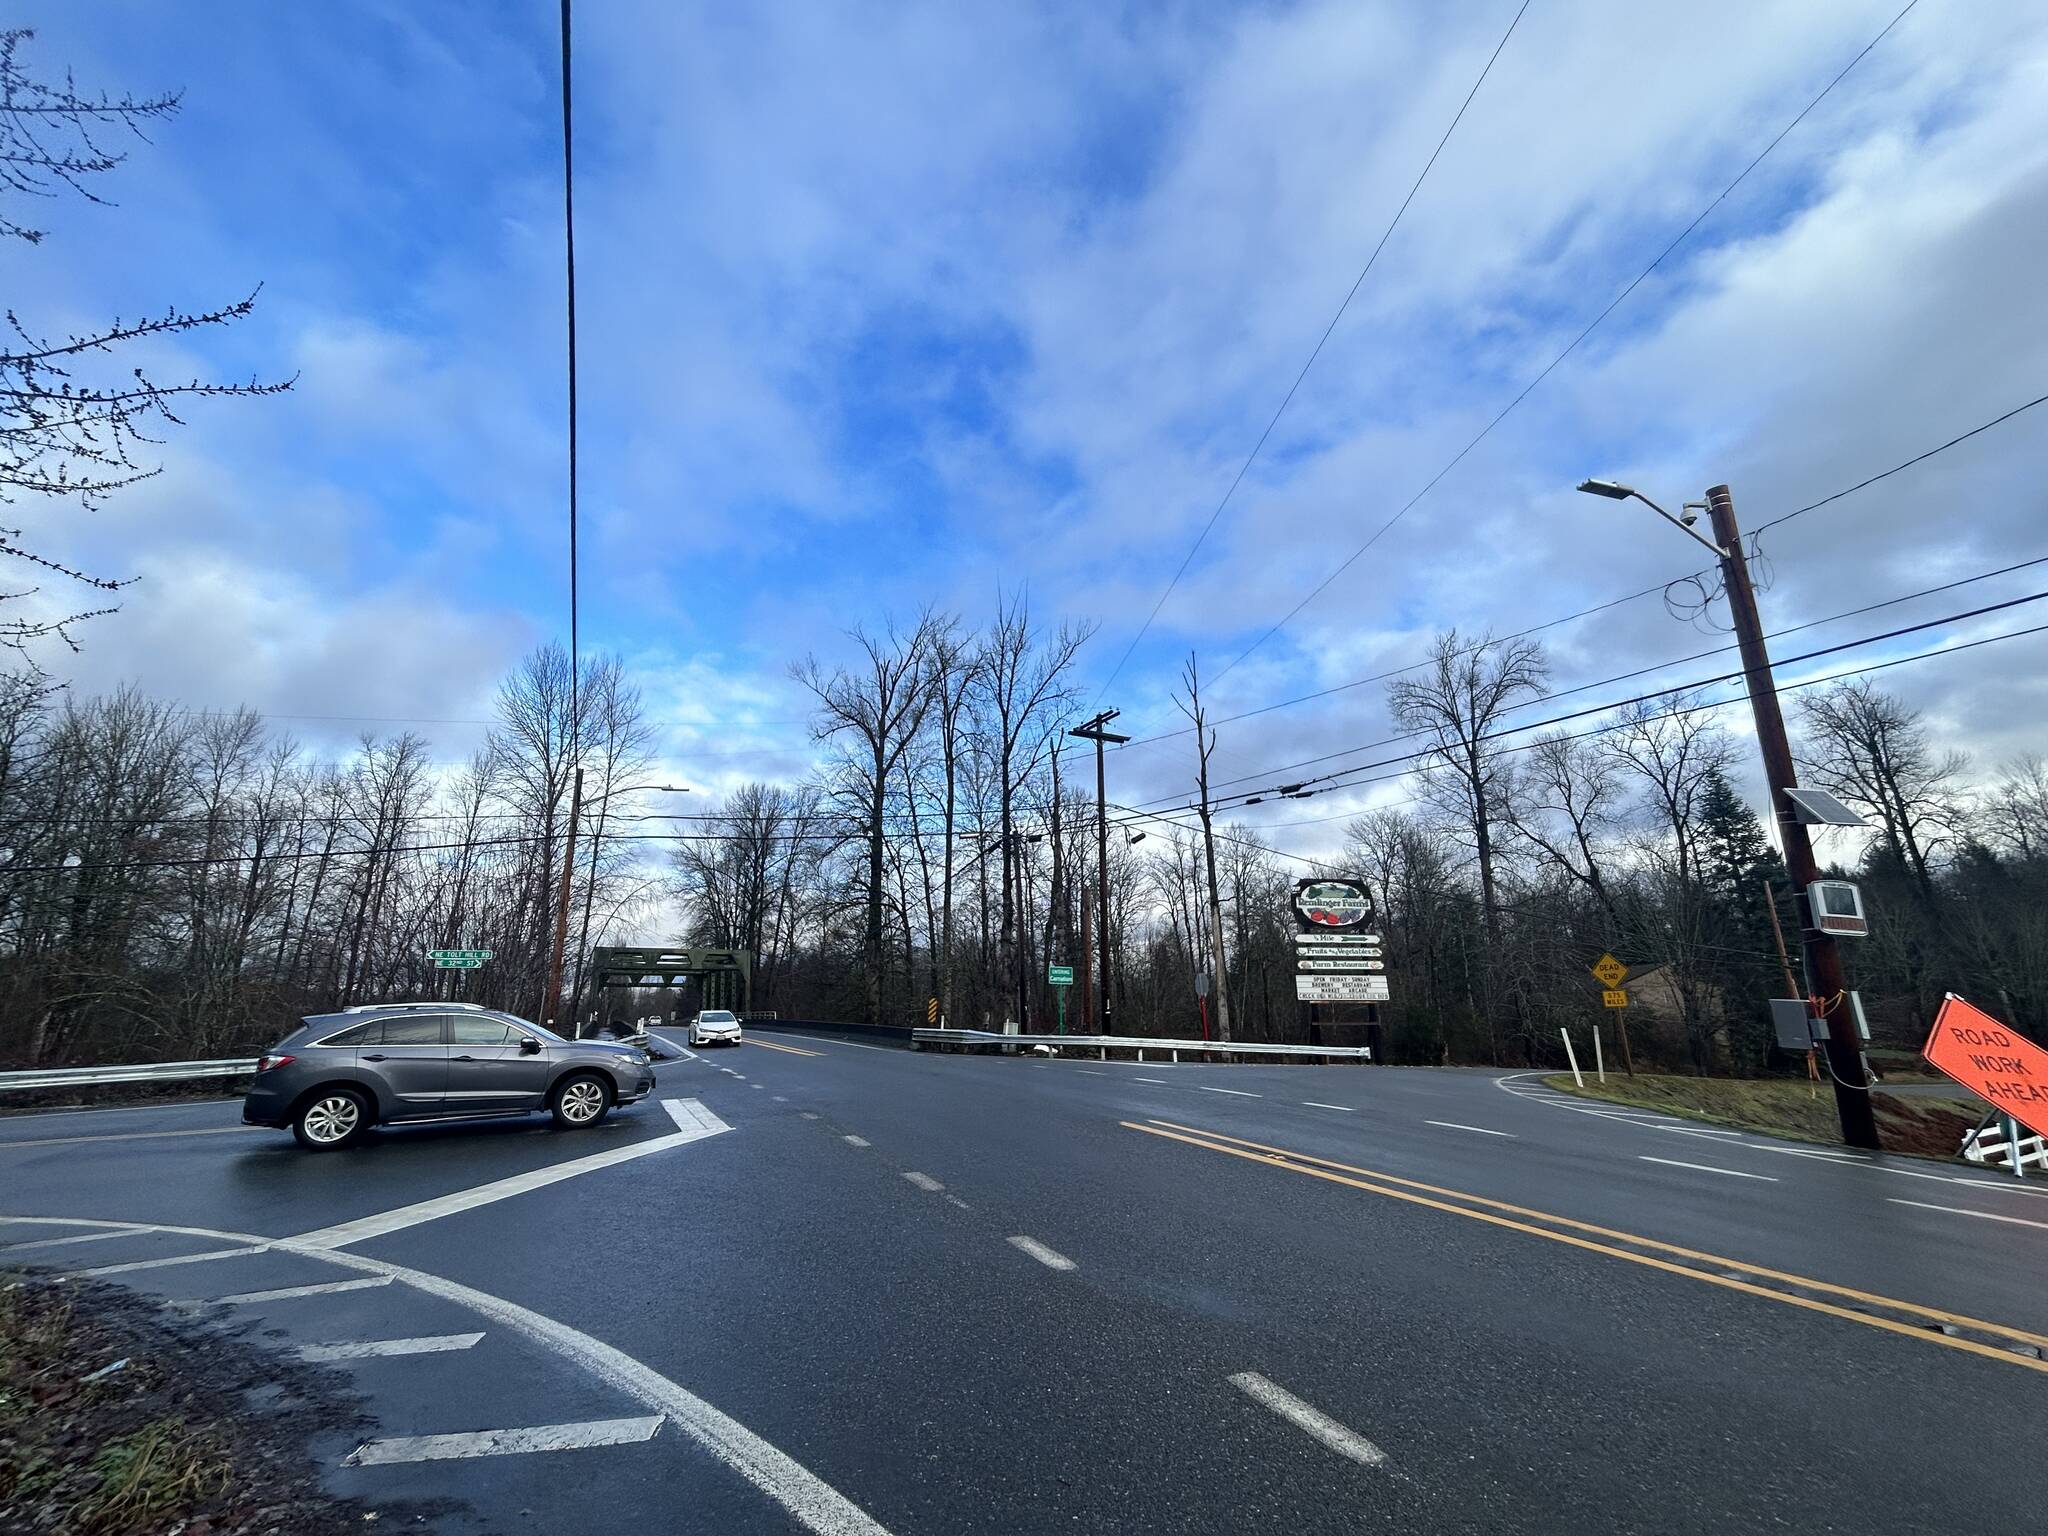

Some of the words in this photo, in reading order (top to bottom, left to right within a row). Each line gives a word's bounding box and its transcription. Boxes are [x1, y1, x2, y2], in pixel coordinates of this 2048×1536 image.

[1298, 897, 1341, 908] Remlinger
[1342, 898, 1369, 908] Farms
[1337, 948, 1371, 956] Vegetables
[1599, 963, 1620, 971] DEAD
[1950, 1027, 2011, 1048] ROAD
[1968, 1054, 2033, 1076] WORK
